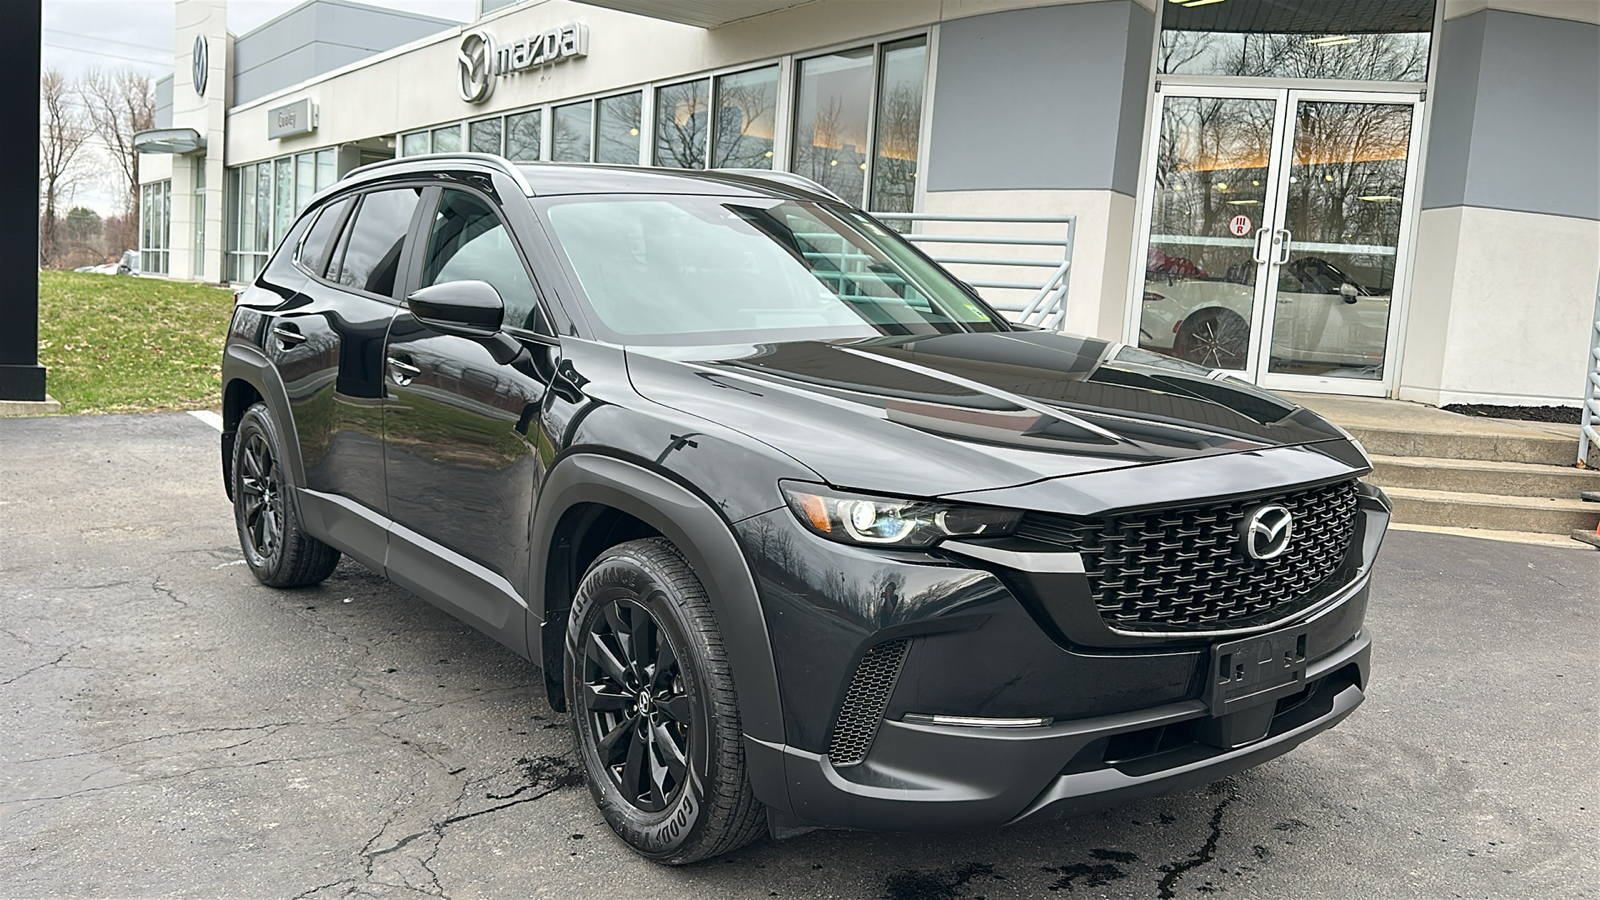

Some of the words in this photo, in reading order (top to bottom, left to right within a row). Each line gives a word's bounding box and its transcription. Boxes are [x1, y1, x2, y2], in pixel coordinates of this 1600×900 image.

[495, 23, 583, 76] mazda
[278, 106, 297, 129] Cooley
[1236, 226, 1243, 234] R
[571, 566, 638, 627] ASSURANCE
